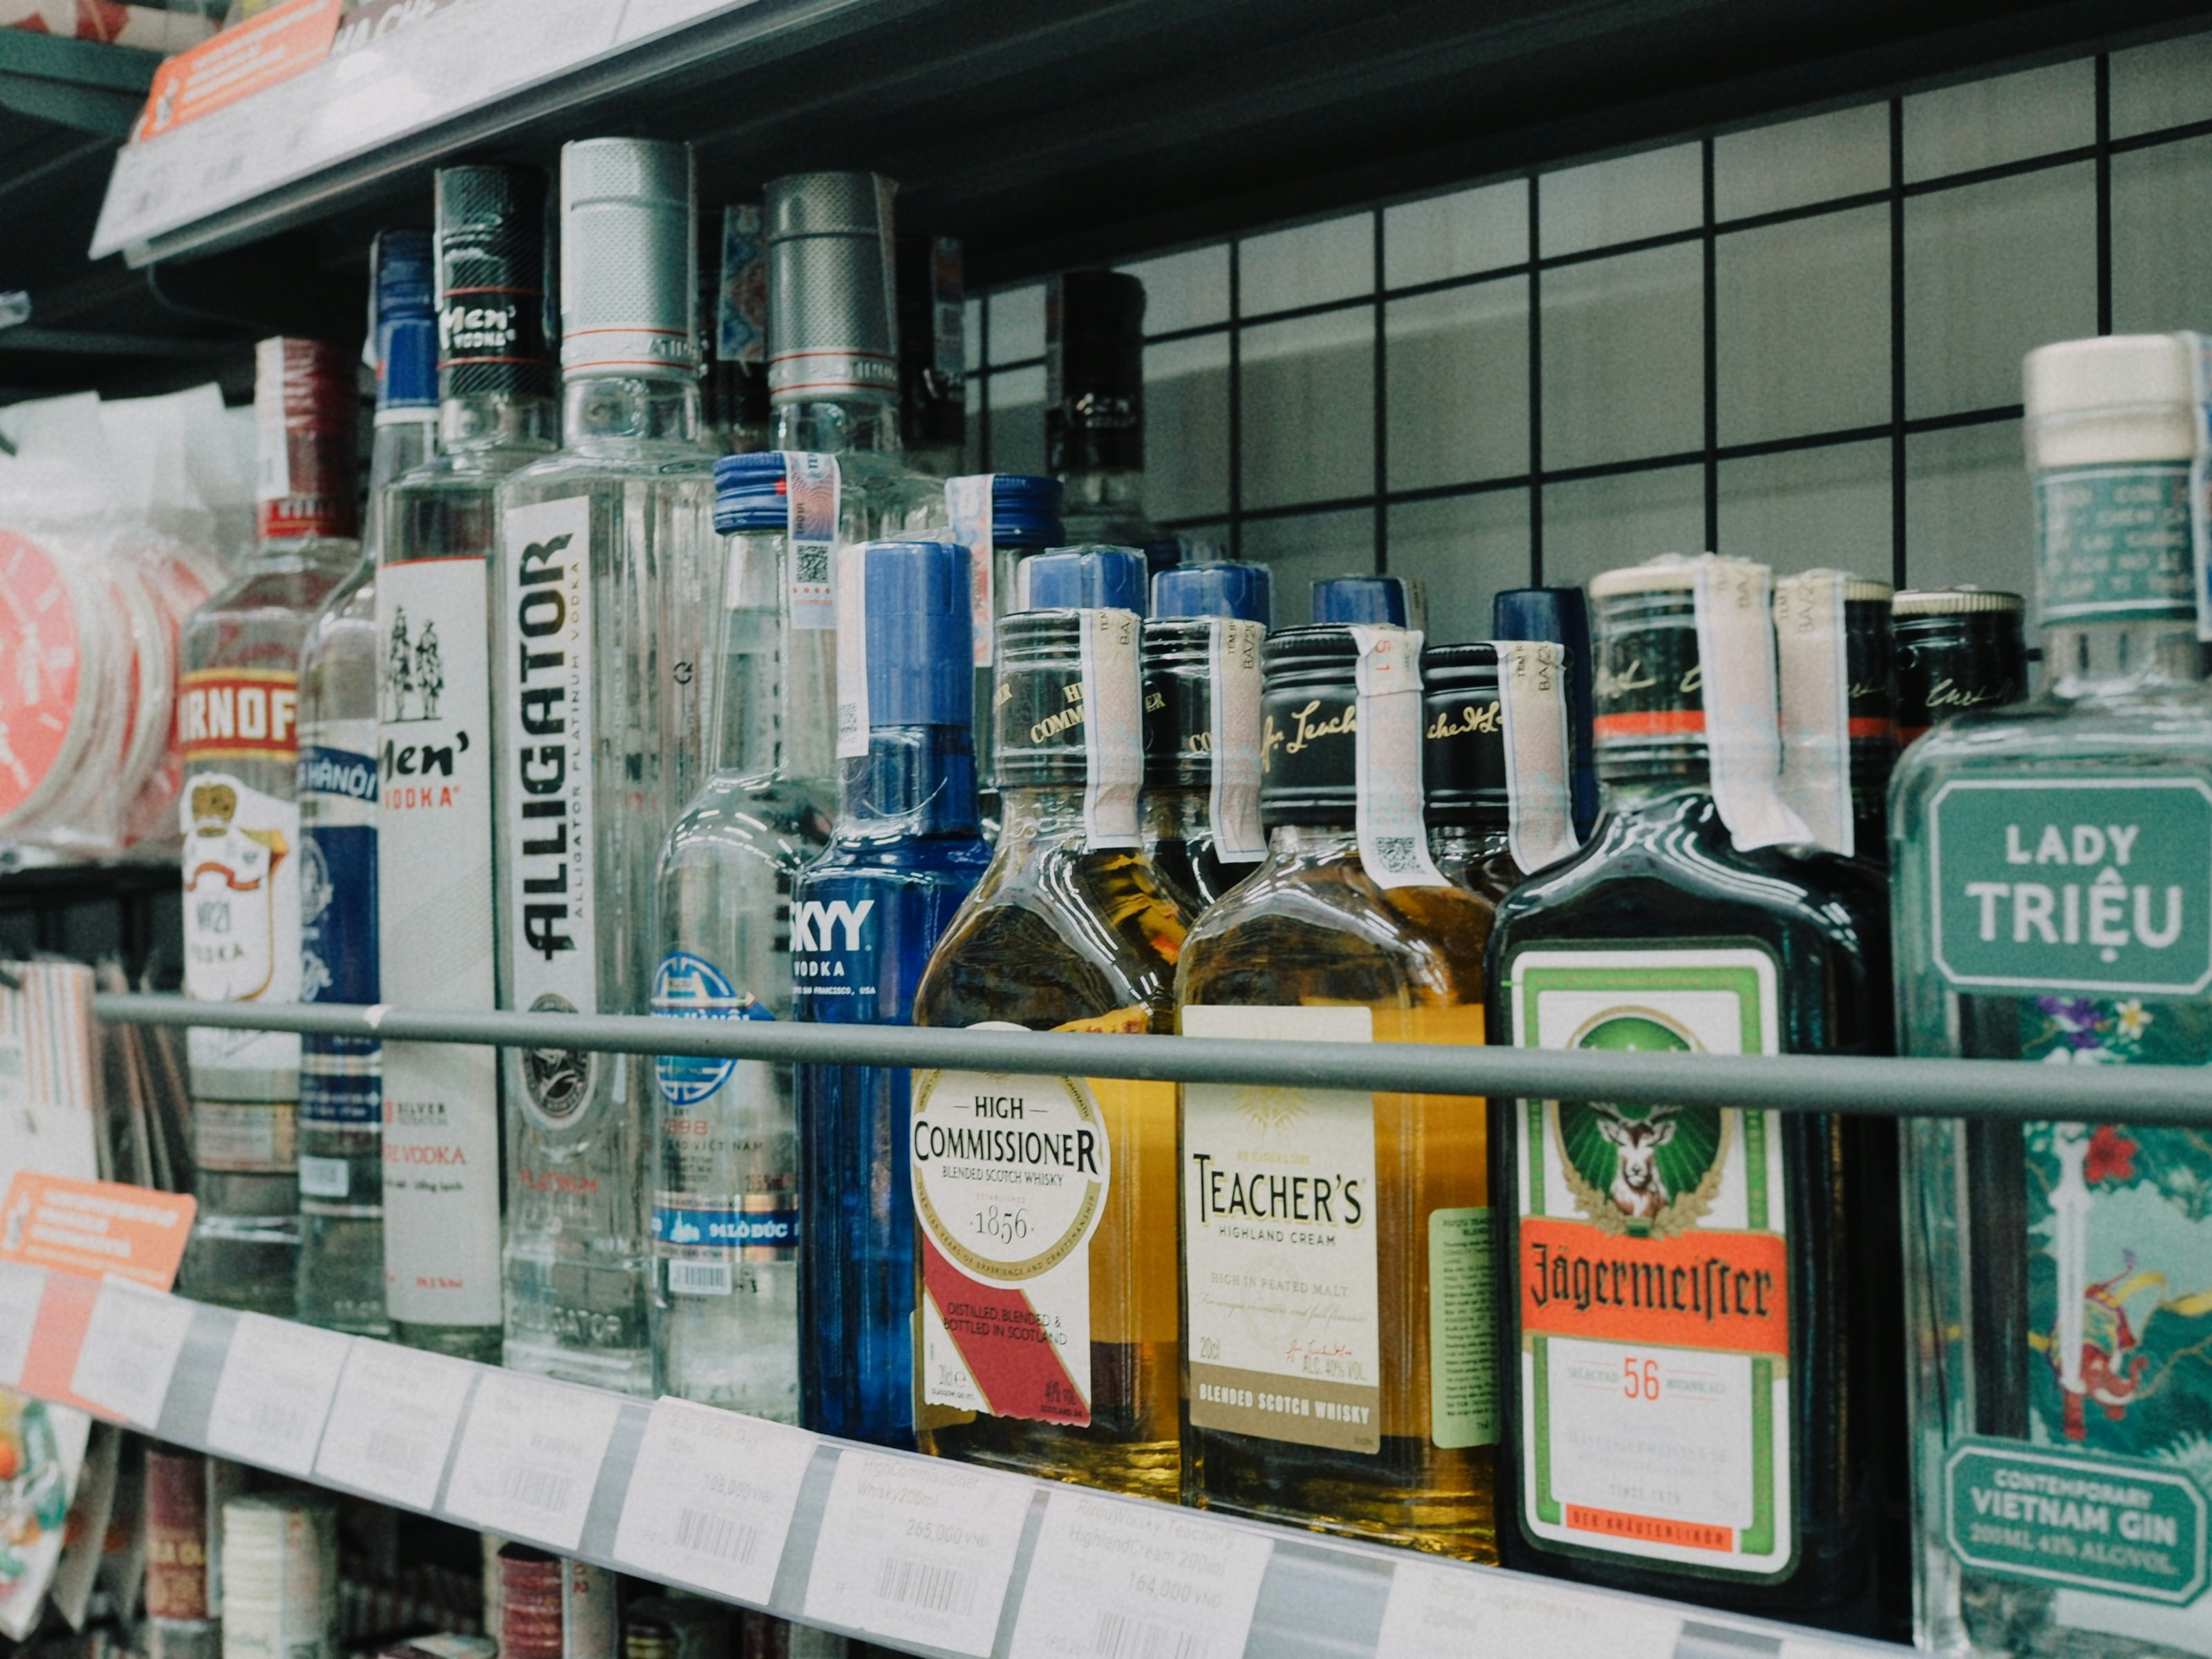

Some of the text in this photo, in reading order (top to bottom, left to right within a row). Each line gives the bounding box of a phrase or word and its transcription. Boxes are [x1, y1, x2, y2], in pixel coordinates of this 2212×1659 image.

[518, 533, 575, 961] ALLIGATOR
[570, 562, 585, 918] ALLIGATOR PLATINUM VODKA
[2006, 824, 2139, 866] LADY
[1965, 865, 2183, 964] TRIỆU
[794, 961, 845, 977] VODKA
[975, 1096, 1024, 1120] HIGH
[403, 1145, 467, 1166] VODKA
[915, 1120, 1099, 1176] COMMISSIONER
[942, 1165, 1065, 1188] BLENDED SCOTCH WHISKY
[1193, 1153, 1365, 1227] TEACHER'S
[975, 1204, 1029, 1244] 1856
[1219, 1225, 1335, 1247] HIGHLAND CREAM
[1027, 1262, 1044, 1273] AND
[1211, 1272, 1349, 1297] HIGH IN PEATED MALT
[944, 1317, 1068, 1346] BOTTLED IN SCOTLAND
[1002, 1309, 1051, 1327] BLENDED
[1054, 1315, 1062, 1329] &
[1624, 1356, 1660, 1401] 56
[1199, 1382, 1370, 1426] BLENDED SCOTCH WHISKY
[1994, 1468, 2153, 1509] CONTEMPORARY
[1970, 1486, 2177, 1546] VIETNAM GIN
